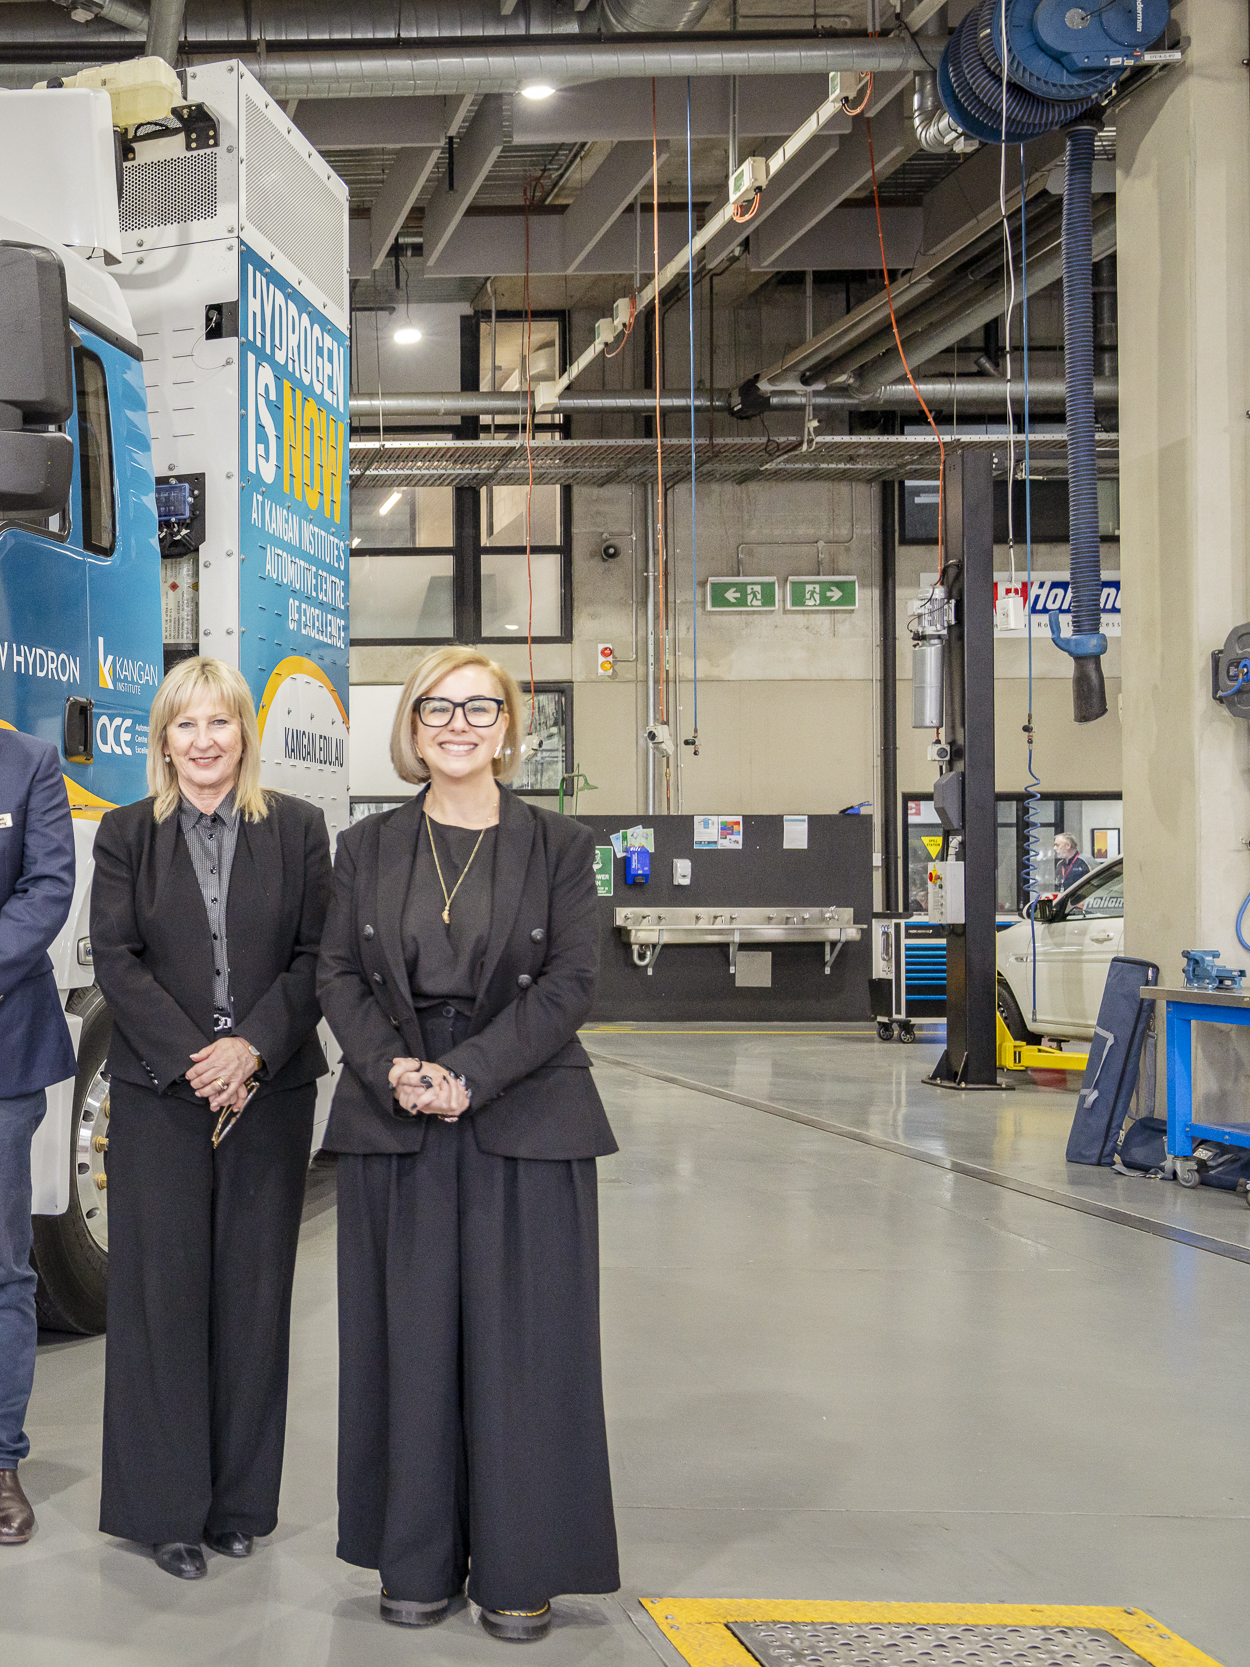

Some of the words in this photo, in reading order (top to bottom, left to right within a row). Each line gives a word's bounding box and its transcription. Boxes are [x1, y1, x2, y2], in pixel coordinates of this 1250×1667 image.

[248, 263, 344, 413] HYDROGEN
[248, 351, 276, 484] IS
[283, 378, 344, 524] NOW
[251, 492, 263, 528] AT
[265, 499, 299, 548] KANGAN
[301, 518, 345, 571] INSTITUTE'S
[265, 544, 317, 597] AUTOMOTIVE
[318, 569, 345, 610] CENTRE
[288, 597, 299, 631] OF
[301, 602, 345, 649] EXCELLENCE
[13, 643, 80, 684] HYDRON
[116, 656, 158, 687] KANGAN
[116, 681, 141, 695] INSTITUTE
[135, 723, 150, 733] Automo
[284, 726, 344, 768] KANGAN.EDU.AU
[134, 745, 149, 755] Excelle
